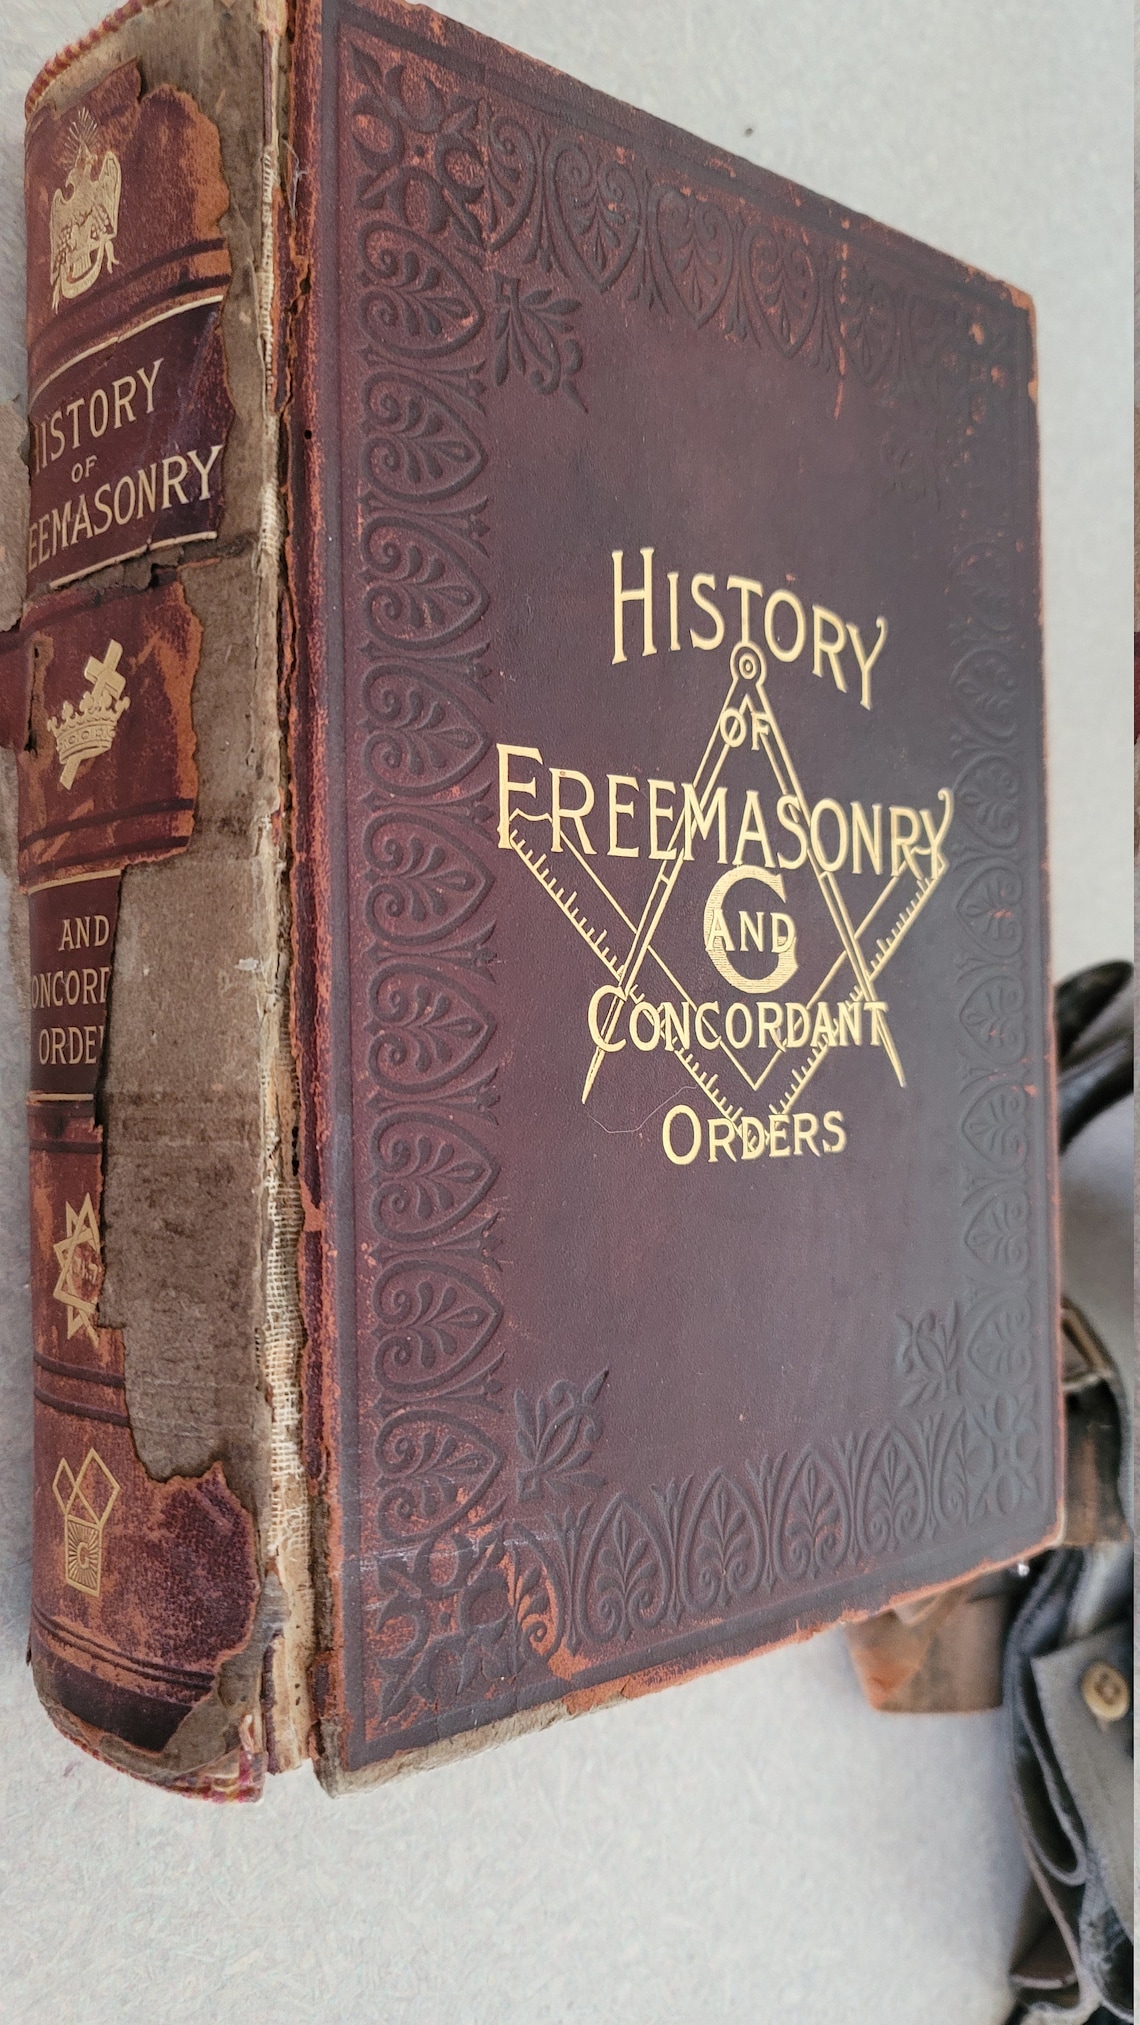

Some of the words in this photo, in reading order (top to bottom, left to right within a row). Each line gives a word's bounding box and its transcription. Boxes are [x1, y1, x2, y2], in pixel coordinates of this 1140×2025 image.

[70, 454, 98, 484] OF
[611, 547, 887, 710] HISTORY
[719, 706, 770, 751] OF
[496, 742, 954, 880] FREEMASONRY
[58, 914, 110, 951] AND
[705, 909, 796, 954] AND
[587, 984, 889, 1053] CONCORDANT
[39, 1025, 104, 1065] ORDE
[661, 1104, 847, 1165] ORDERS
